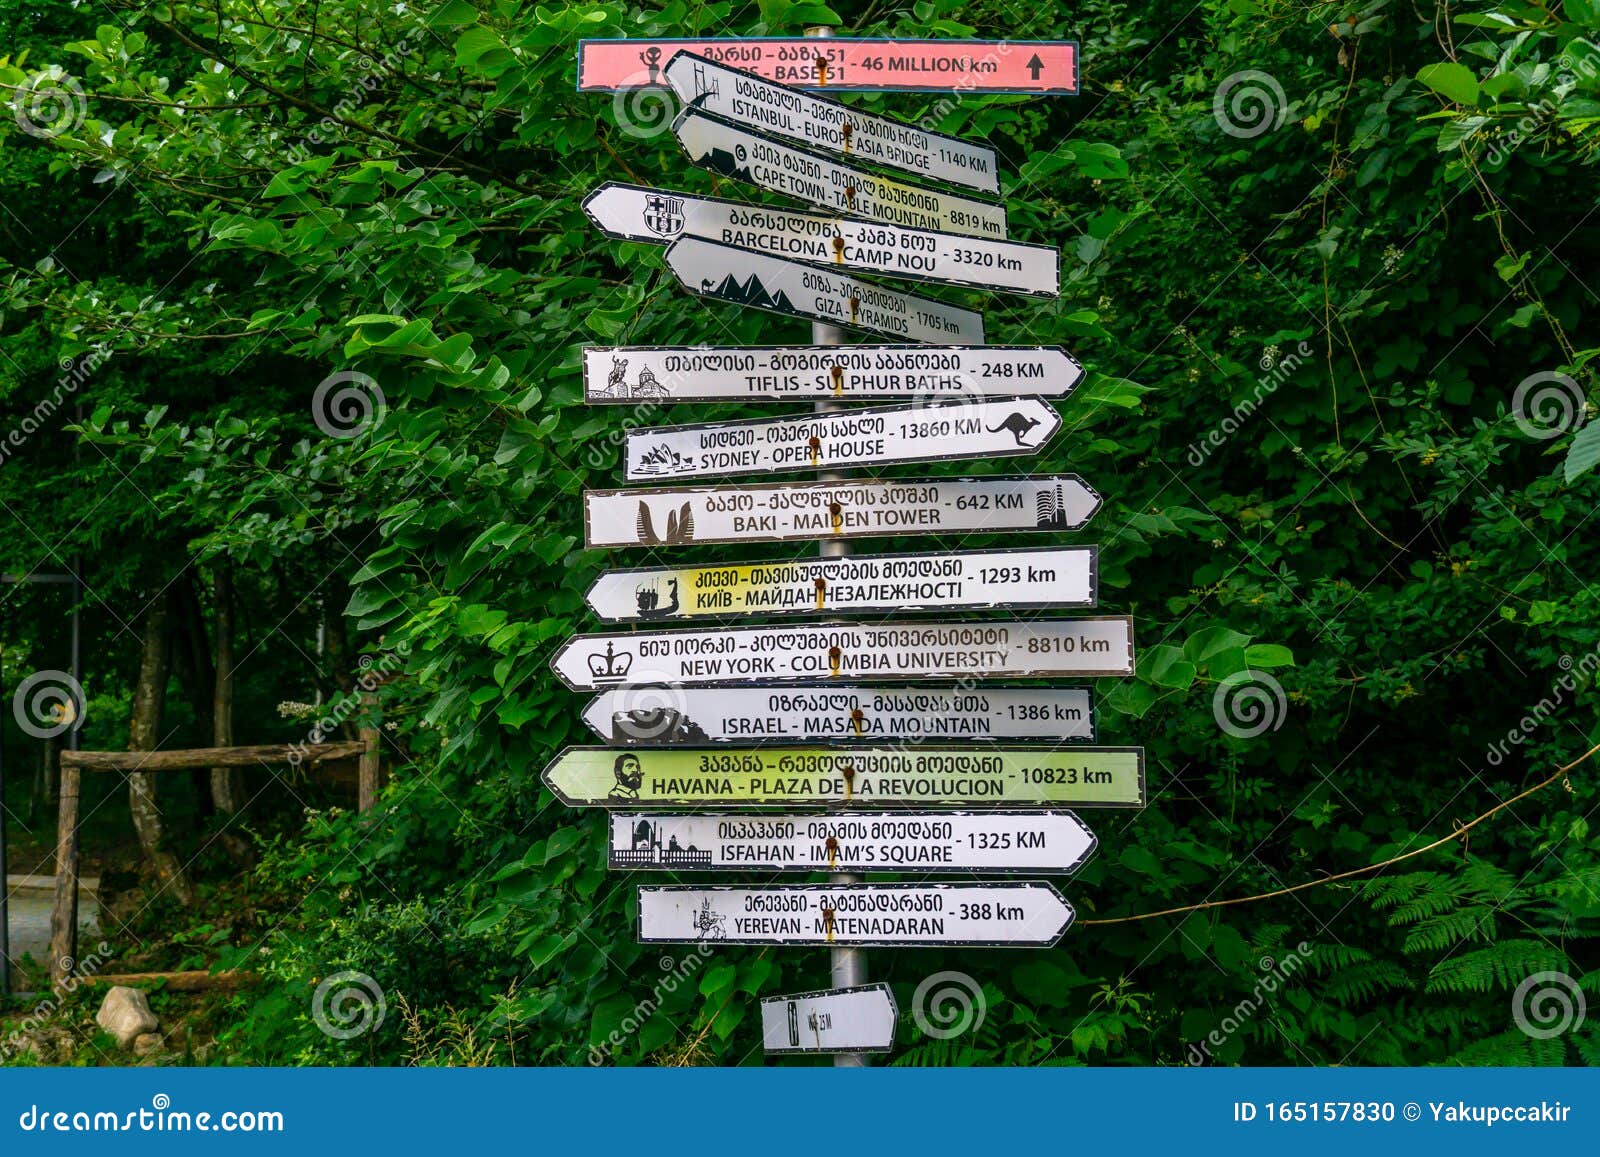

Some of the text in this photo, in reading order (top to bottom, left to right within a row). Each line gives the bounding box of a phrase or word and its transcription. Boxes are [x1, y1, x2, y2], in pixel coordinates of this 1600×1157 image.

[703, 47, 845, 62] მარსი ბაზა 51
[862, 57, 997, 72] 46 MILLION km
[775, 66, 818, 80] BASE
[827, 66, 845, 80] 51
[736, 78, 802, 113] სტამბული
[862, 119, 896, 142] აზიის
[899, 130, 928, 150] ხიდი
[732, 98, 930, 170] ISTANBUL EUROPE ASIA BRIDGE
[940, 149, 988, 174] 1140 KM
[752, 143, 781, 166] კეიპ
[784, 154, 821, 180] ტაუნი
[879, 184, 939, 213] მაუნტინი
[754, 165, 940, 230] CAPE TOWN TABLE MOUNTAIN
[730, 208, 936, 252] ბარსელონა კამპ ნოუ
[950, 210, 1001, 234] 8819 km
[722, 228, 936, 272] BARCELONA CAMP NOU
[953, 249, 1022, 271] 3320 km
[802, 272, 832, 293] გიზა
[815, 297, 908, 334] GIZA PYRAMIDS
[917, 312, 960, 335] 1705 km
[665, 354, 960, 371] თბილისი გოგირდის აბანოები
[982, 363, 1044, 378] 248 KM
[745, 375, 962, 391] TIFLIS SULPHUR BATHS
[700, 417, 884, 450] სიდნეი ოპერის სახლი
[900, 418, 982, 440] 13860 KM
[700, 439, 885, 470] SYDNEY OPERA HOUSE
[706, 487, 939, 512] ბაქო ქალწულის კოშკი
[956, 494, 1024, 510] 642 KM
[734, 508, 941, 532] BAKI MAIDEN TOWER
[696, 570, 738, 588] კიევი
[882, 559, 963, 579] მოედანი
[980, 566, 1056, 584] 1293 km
[697, 589, 732, 608] КИЇВ
[745, 586, 817, 608] МАЙДАН
[639, 628, 1009, 657] ნიუ იორკი კოლუმბიის უნივერსიტეტი
[1028, 636, 1110, 653] 8810 km
[680, 650, 1011, 676] NEW YORK COLUMBIA UNIVERSITY
[768, 694, 990, 712] იზრაელი მასადას მთა
[1008, 704, 1082, 720] 1386 km
[722, 718, 990, 734] ISRAEL MASADA MOUNTAIN
[699, 755, 764, 773] ჰავანა
[916, 756, 1004, 774] მოედანი
[1022, 766, 1112, 784] 10823 km
[652, 778, 1004, 796] HAVANA PLAZA DE LA REVOLUCION
[718, 822, 953, 840] ისპაჰანი იმამის მოედანი
[968, 832, 1046, 850] 1325 KM
[721, 844, 795, 862] ISFAHAN
[880, 845, 953, 864] SQUARE
[744, 894, 808, 913] ერევანი
[960, 902, 1024, 921] 388 km
[734, 918, 945, 936] YEREVAN MATENADARAN
